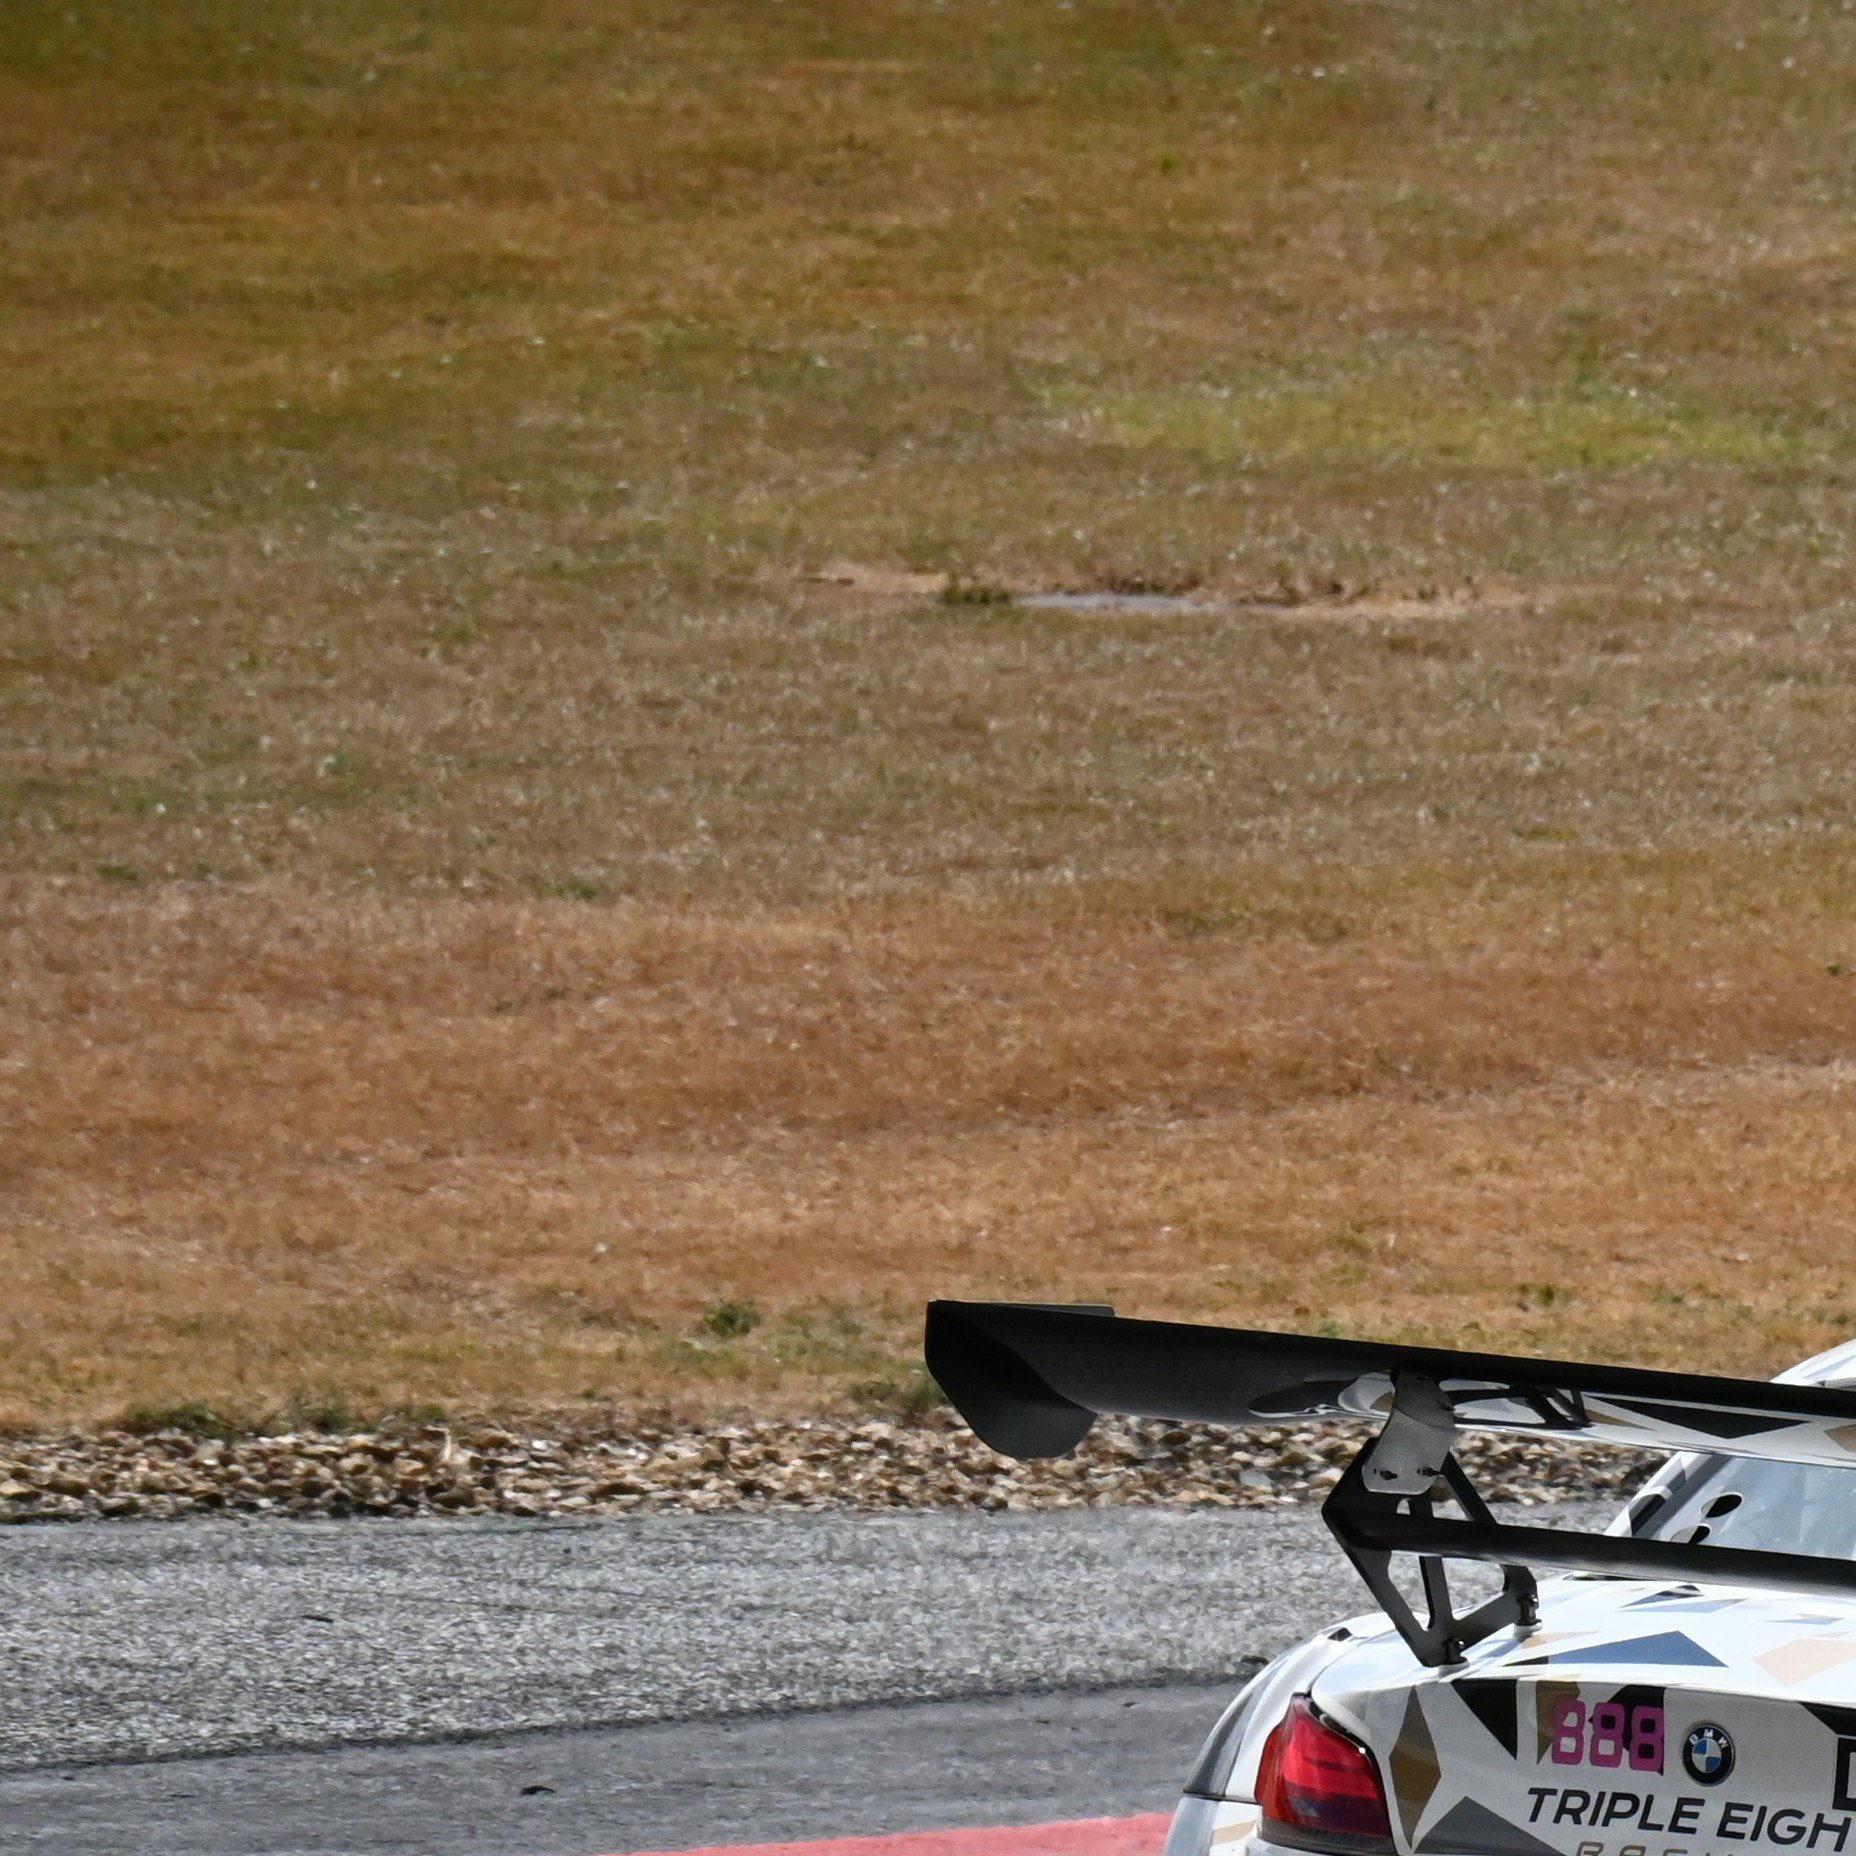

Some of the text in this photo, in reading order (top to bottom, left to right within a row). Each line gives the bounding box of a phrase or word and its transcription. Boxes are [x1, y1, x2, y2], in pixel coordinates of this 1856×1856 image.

[1551, 1700, 1664, 1772] 888
[1689, 1728, 1729, 1749] BMW
[1528, 1787, 1706, 1835] TRIPLE
